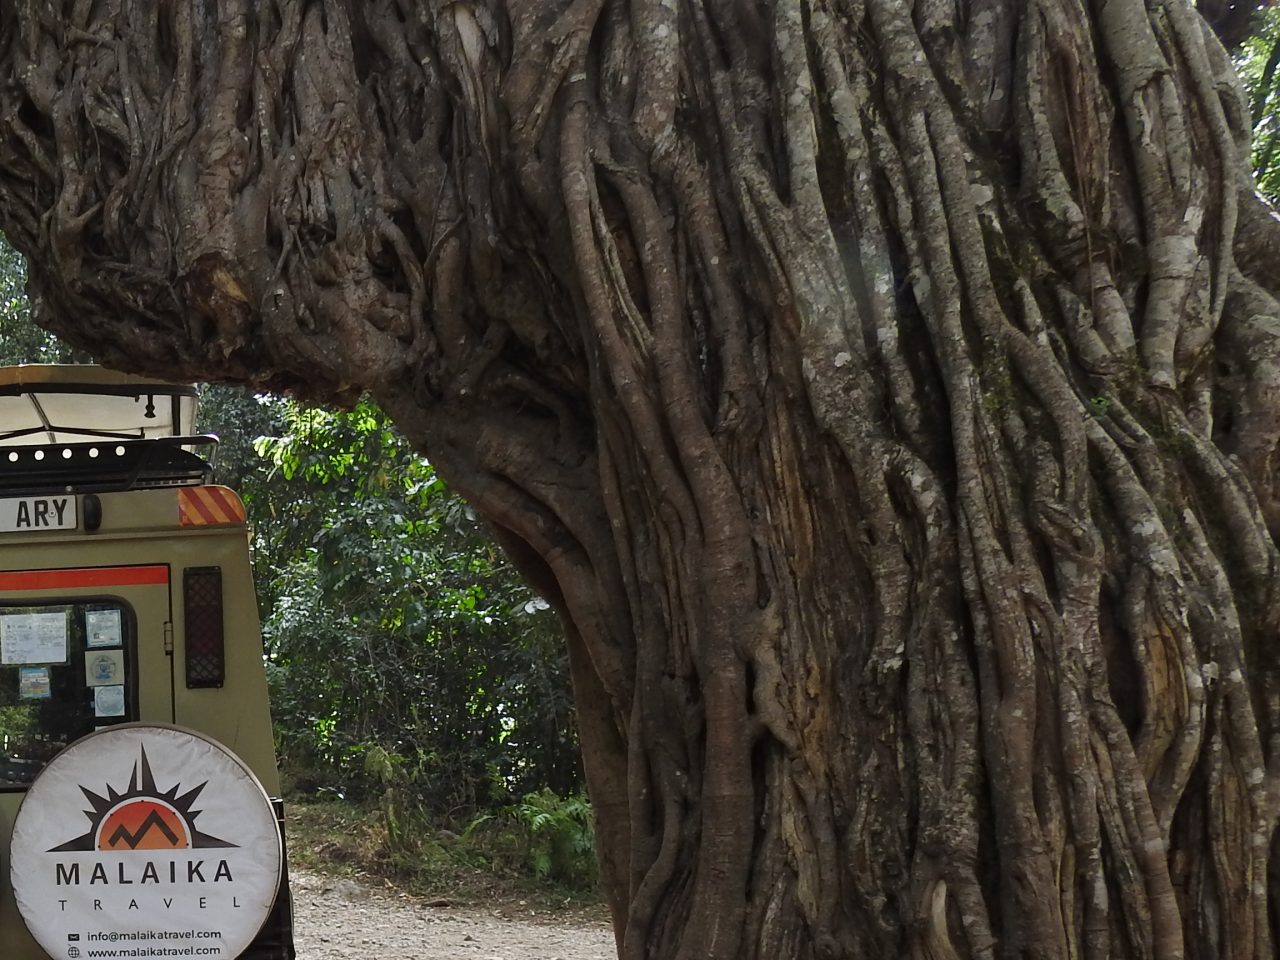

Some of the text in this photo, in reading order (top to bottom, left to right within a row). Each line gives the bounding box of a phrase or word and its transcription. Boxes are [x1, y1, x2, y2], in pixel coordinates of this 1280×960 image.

[16, 498, 68, 527] ARY
[56, 859, 233, 886] MALAIKA
[58, 896, 241, 912] TRAVEL
[87, 929, 222, 942] info@malaikatravel.com
[87, 945, 221, 958] www.malaikatravel.com
